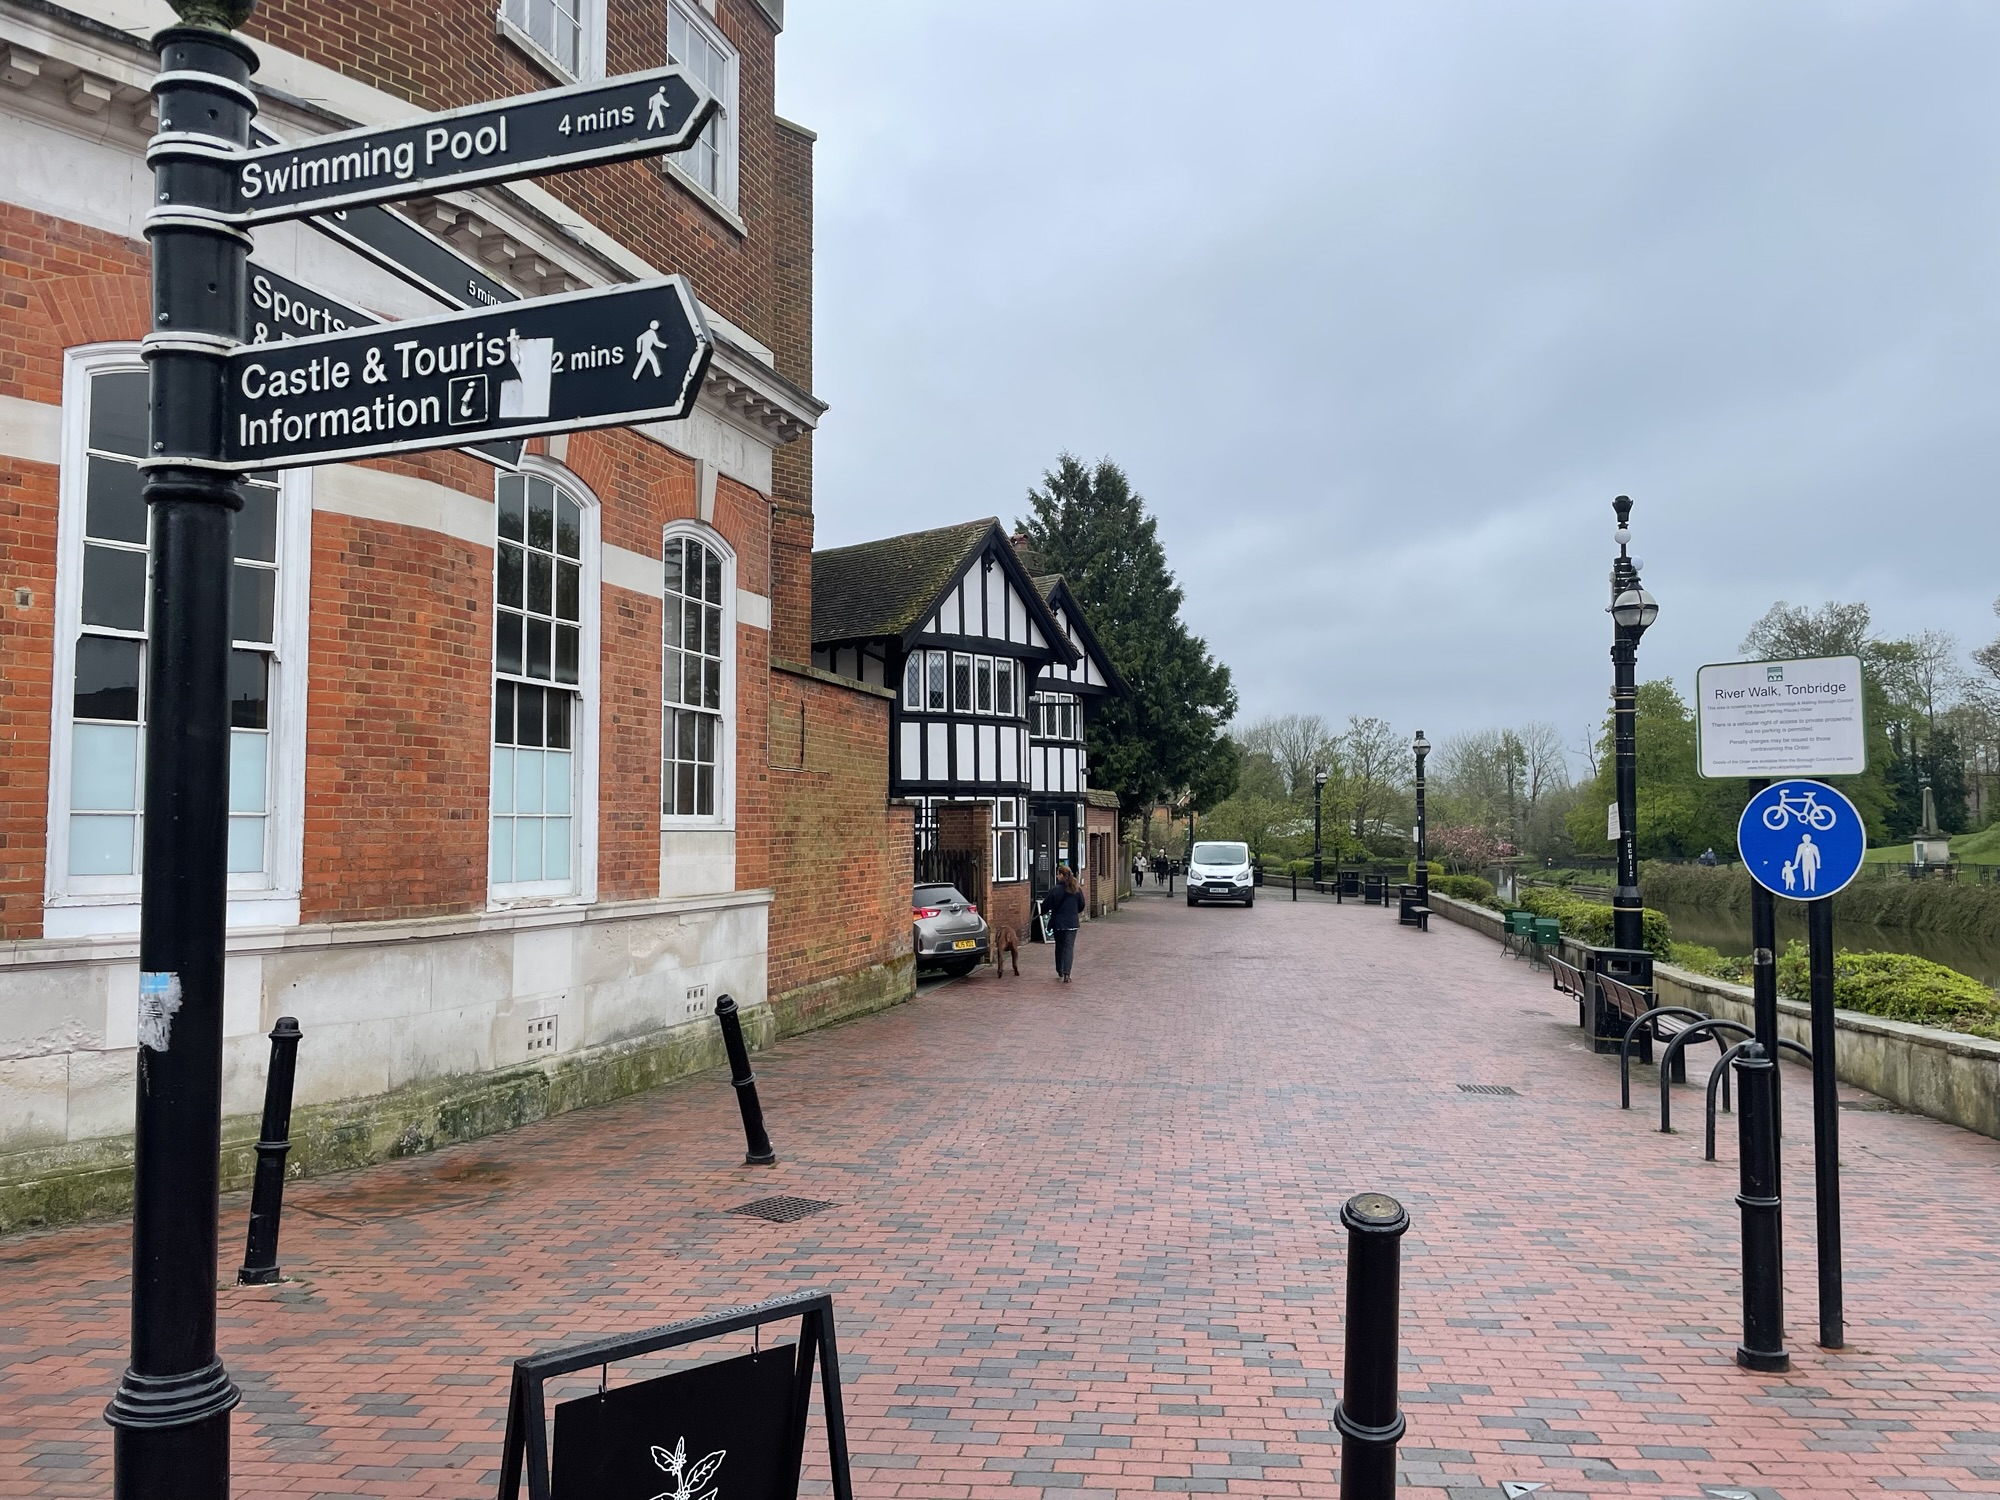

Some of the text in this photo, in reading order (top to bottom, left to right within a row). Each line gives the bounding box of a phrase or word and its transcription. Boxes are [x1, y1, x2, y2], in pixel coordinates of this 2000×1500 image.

[240, 106, 635, 198] Swimming Pool 4 mins
[468, 280, 502, 306] 5 min
[242, 327, 624, 400] Castle & Tourist 2 mins
[240, 395, 440, 447] Information
[1716, 683, 1846, 700] River Walk, Tonbridge
